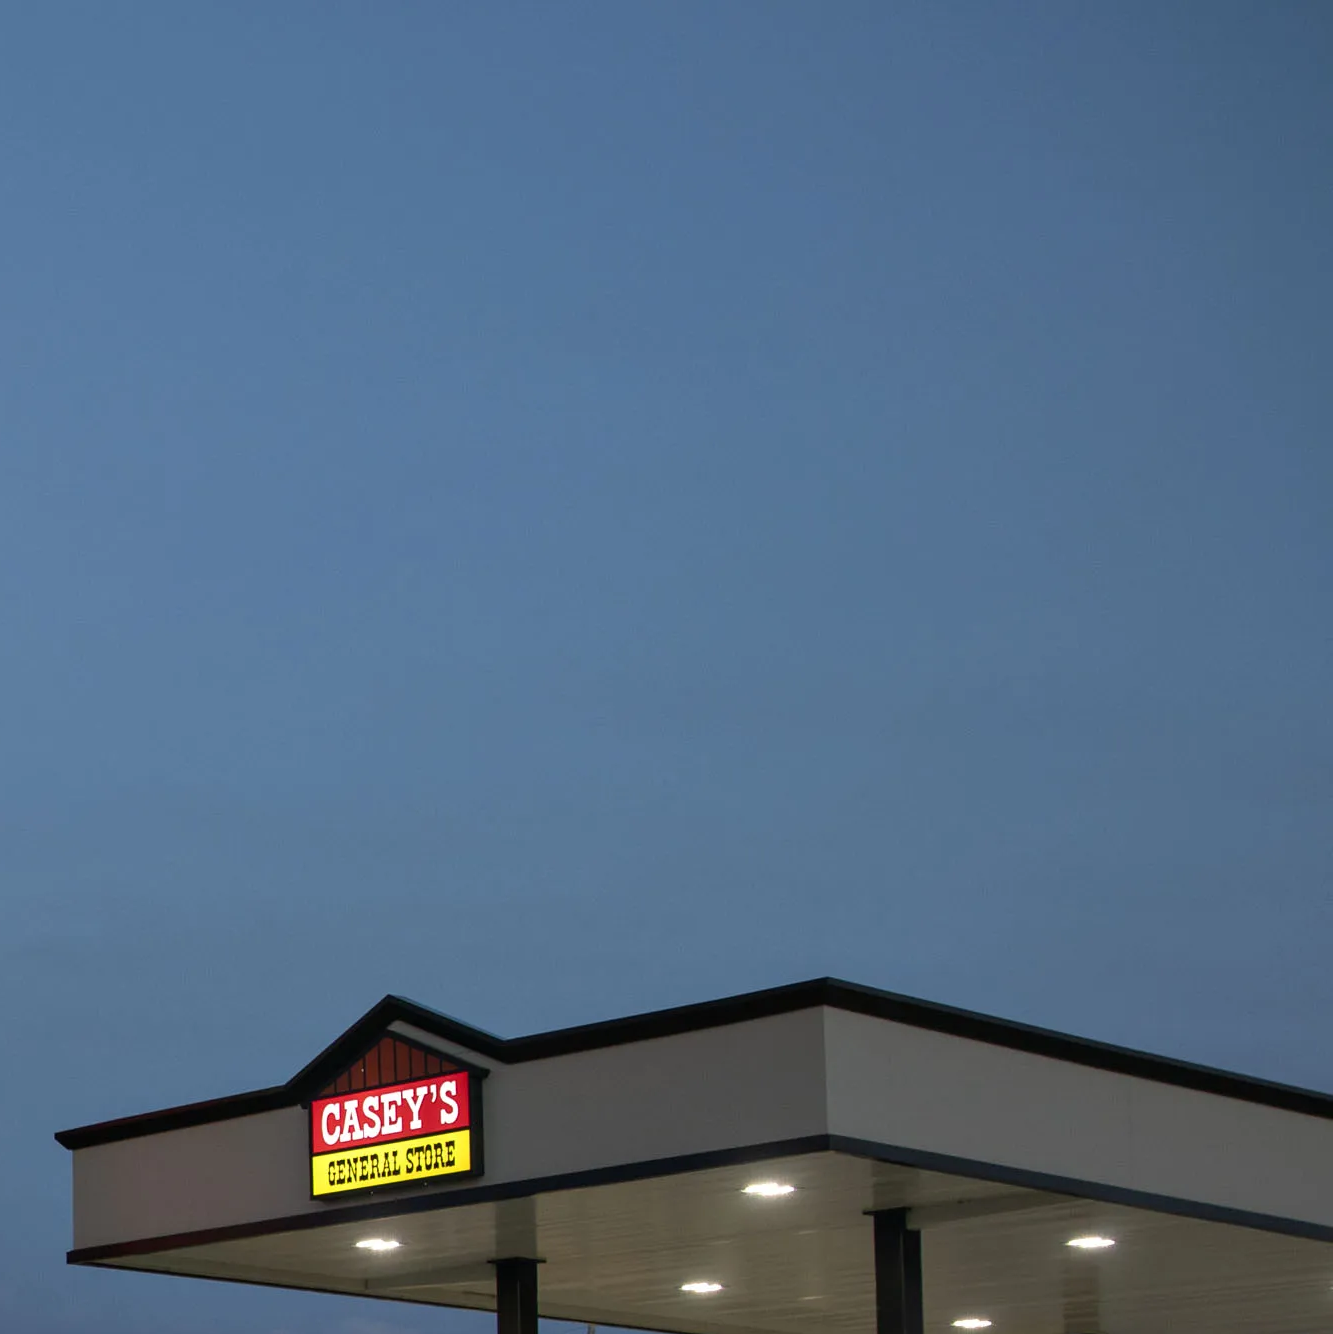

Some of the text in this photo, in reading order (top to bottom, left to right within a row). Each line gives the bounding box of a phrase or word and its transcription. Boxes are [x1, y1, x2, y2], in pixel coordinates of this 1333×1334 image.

[321, 1080, 459, 1146] CASEY'S
[328, 1140, 456, 1187] GENERAL STORE
